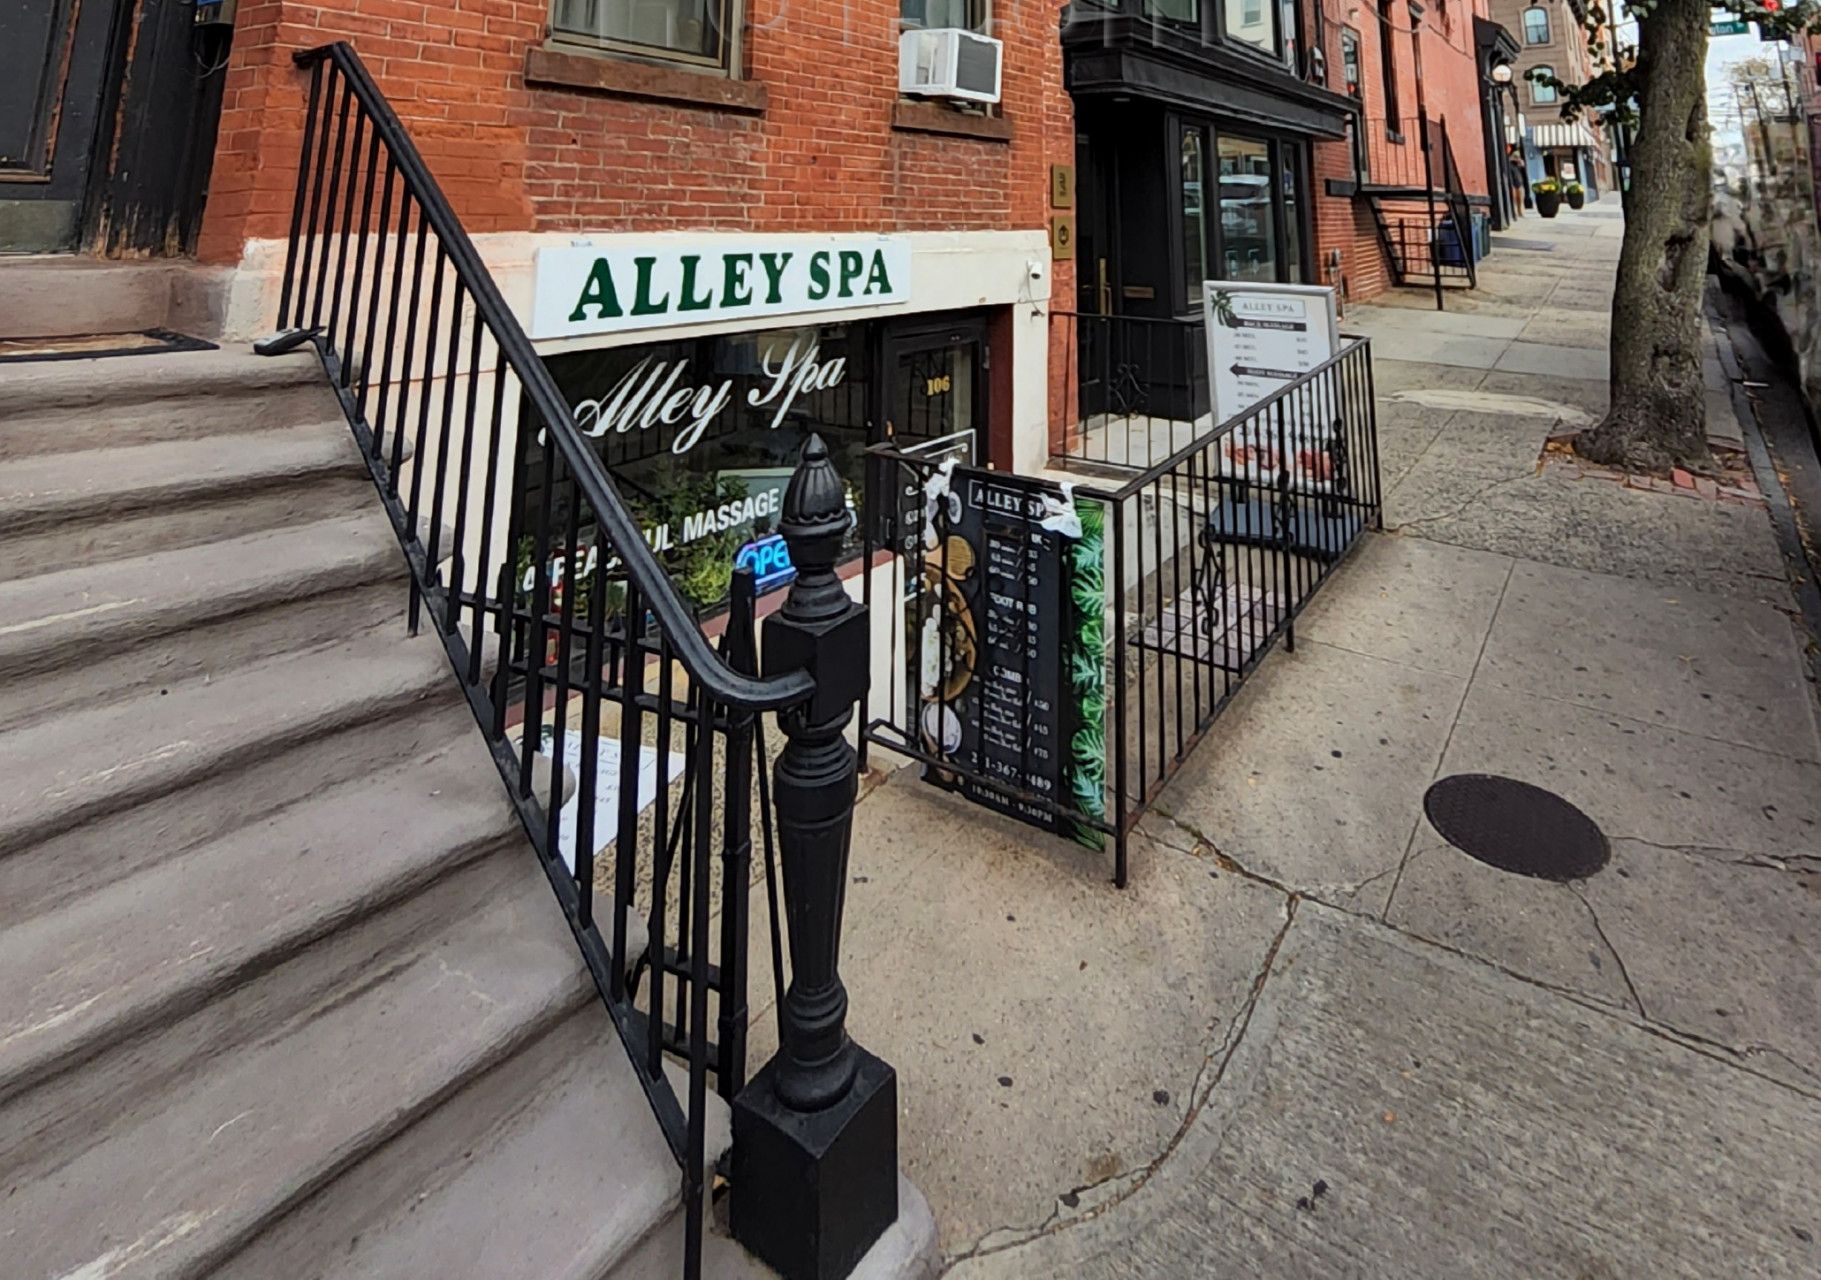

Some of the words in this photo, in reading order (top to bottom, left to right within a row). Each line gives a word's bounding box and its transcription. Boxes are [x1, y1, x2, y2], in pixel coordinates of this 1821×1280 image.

[568, 252, 793, 322] ALLEY
[808, 249, 893, 300] SPA
[538, 352, 732, 455] Alley
[747, 330, 846, 429] Spa
[926, 376, 950, 397] 106
[683, 488, 780, 543] MASSAGE
[974, 488, 1023, 512] ALLEY
[1027, 501, 1047, 518] SP
[743, 540, 791, 577] OPE
